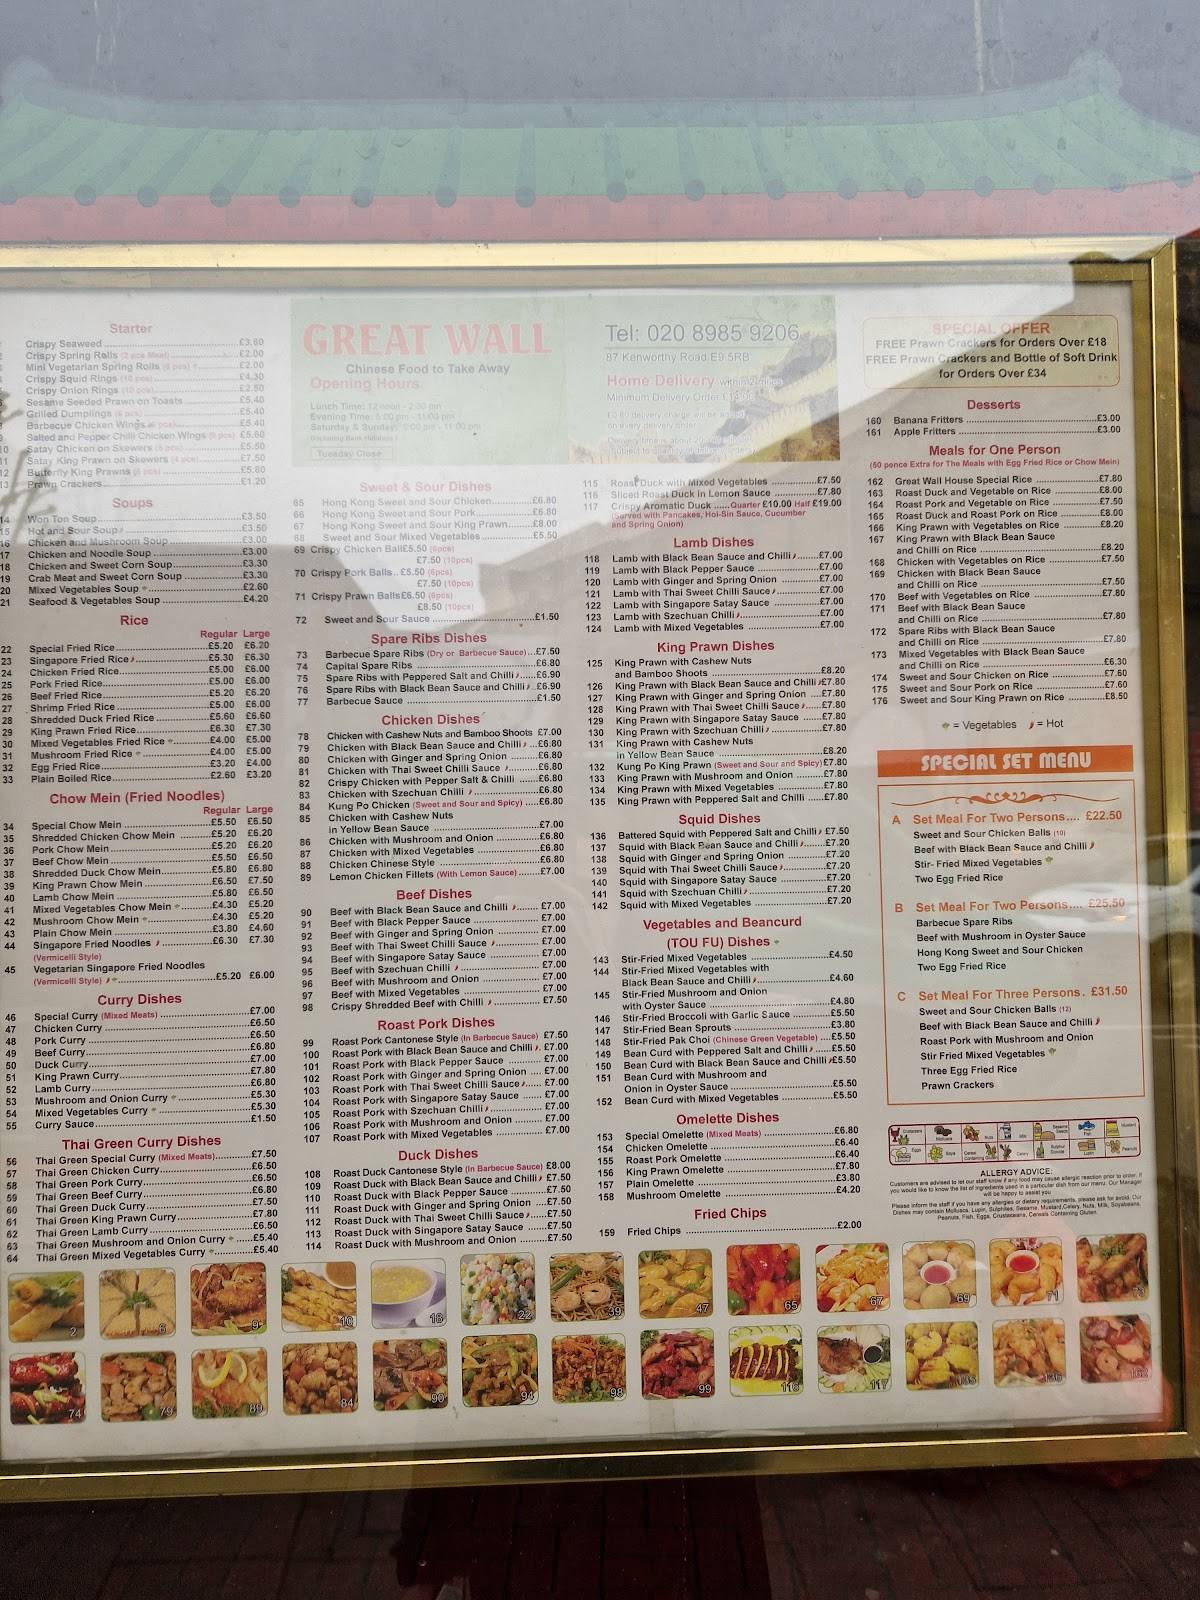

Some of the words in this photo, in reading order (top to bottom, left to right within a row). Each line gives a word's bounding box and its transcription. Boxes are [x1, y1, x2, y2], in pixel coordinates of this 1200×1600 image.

[109, 322, 153, 334] Starter
[604, 323, 639, 342] Tel:
[647, 322, 687, 343] 020
[692, 323, 743, 342] 8985
[749, 323, 802, 344] 9206
[932, 322, 996, 336] SPECIAL
[996, 322, 1050, 336] OFFER
[303, 322, 433, 355] GREAT
[442, 323, 551, 354] WALL
[875, 338, 907, 349] FREE
[909, 338, 944, 348] Prawn
[946, 337, 997, 348] Crackers
[999, 337, 1015, 347] for
[1018, 337, 1055, 347] Orders
[1058, 337, 1085, 347] Over
[1087, 336, 1106, 346] £18
[622, 351, 679, 364] Kenworthy
[679, 351, 709, 362] Road
[345, 363, 394, 374] Chinese
[398, 363, 428, 374] Food
[432, 364, 444, 374] to
[447, 363, 474, 374] Take
[478, 363, 510, 376] Away
[938, 368, 954, 379] for
[957, 368, 995, 378] Orders
[998, 368, 1025, 378] Over
[1027, 367, 1046, 377] £34
[310, 378, 371, 392] Opening
[376, 377, 420, 390] Hours
[607, 374, 649, 387] Home
[656, 374, 715, 388] Delivery
[967, 399, 1020, 410] Desserts
[929, 444, 964, 456] Meals
[968, 444, 986, 455] for
[989, 444, 1014, 455] One
[1017, 443, 1060, 454] Person
[360, 482, 400, 493] Sweet
[402, 482, 410, 493] &
[414, 480, 445, 492] Sour
[448, 480, 492, 492] Dishes
[111, 497, 154, 510] Soups
[673, 536, 708, 548] Lamb
[711, 536, 754, 547] Dishes
[0, 574, 10, 583] 19
[27, 573, 51, 582] Crab
[53, 573, 77, 582] Meat
[78, 573, 96, 581] and
[99, 572, 128, 581] Sweet
[130, 572, 154, 580] Corn
[156, 571, 182, 582] Soup
[243, 570, 268, 579] £3.30
[120, 614, 148, 625] Rice
[200, 629, 238, 640] Regular
[242, 629, 270, 639] Large
[371, 633, 408, 646] Spare
[411, 632, 440, 644] Ribs
[444, 632, 487, 643] Dishes
[657, 641, 686, 655] King
[689, 641, 728, 652] Prawn
[732, 640, 774, 651] Dishes
[381, 714, 432, 725] Chicken
[437, 713, 480, 725] Dishes
[962, 719, 1016, 732] Vegetables
[297, 732, 309, 741] 78
[326, 731, 363, 740] Chicken
[364, 731, 383, 739] with
[385, 730, 421, 739] Cashew
[422, 730, 443, 738] Nuts
[444, 729, 461, 738] and
[463, 729, 500, 737] Bamboo
[502, 728, 533, 736] Shoots
[537, 727, 562, 736] £7.00
[920, 753, 997, 771] SPECIAL
[1002, 752, 1033, 769] SET
[1038, 751, 1091, 768] MENU
[49, 793, 87, 804] Chow
[90, 791, 120, 803] Mein
[124, 791, 162, 805] (Fried
[167, 789, 224, 803] Noodles)
[678, 813, 714, 826] Squid
[718, 813, 760, 823] Dishes
[891, 814, 901, 824] A
[912, 814, 933, 824] Set
[935, 813, 963, 824] Meal
[966, 813, 987, 823] For
[989, 812, 1013, 823] Two
[1085, 810, 1122, 821] £22.50
[396, 888, 425, 900] Beef
[429, 888, 472, 899] Dishes
[642, 918, 711, 932] Vegetables
[714, 917, 738, 928] and
[742, 915, 801, 927] Beancurd
[916, 919, 960, 927] Barbecue
[962, 918, 989, 928] Spare
[992, 917, 1013, 925] Ribs
[3, 929, 15, 938] 43
[32, 929, 56, 938] Plain
[59, 928, 86, 936] Chow
[89, 927, 112, 936] Mein
[212, 924, 237, 933] £3.80
[248, 922, 274, 932] £4.60
[916, 933, 938, 941] Beef
[939, 933, 959, 941] with
[962, 932, 1010, 941] Mushroom
[1013, 931, 1022, 939] in
[1024, 931, 1056, 941] Oyster
[1057, 930, 1086, 939] Sauce
[666, 937, 697, 950] (TOU
[702, 936, 723, 950] FU)
[727, 936, 770, 947] Dishes
[897, 991, 906, 1001] C
[918, 990, 938, 1001] Set
[941, 989, 968, 1000] Meal
[972, 989, 992, 1000] For
[995, 988, 1028, 999] Three
[1090, 985, 1127, 996] £31.50
[97, 994, 133, 1007] Curry
[137, 993, 182, 1004] Dishes
[4, 1025, 16, 1034] 47
[34, 1024, 73, 1033] Chicken
[75, 1023, 102, 1033] Curry
[250, 1017, 275, 1027] £6.50
[377, 1019, 415, 1030] Roast
[418, 1018, 448, 1029] Pork
[451, 1017, 495, 1028] Dishes
[920, 1066, 947, 1075] Three
[949, 1066, 968, 1076] Egg
[970, 1065, 994, 1074] Fried
[997, 1064, 1017, 1073] Rice
[921, 1081, 950, 1090] Prawn
[953, 1080, 994, 1089] Crackers
[676, 1113, 732, 1125] Omelette
[736, 1112, 779, 1123] Dishes
[61, 1138, 89, 1150] Thai
[93, 1138, 133, 1149] Green
[137, 1136, 173, 1149] Curry
[177, 1135, 221, 1146] Dishes
[398, 1149, 431, 1161] Duck
[435, 1147, 478, 1160] Dishes
[980, 1168, 1018, 1177] ALLERGY
[694, 1208, 726, 1220] Fried
[730, 1207, 767, 1220] Chips
[599, 1228, 615, 1237] 159
[627, 1227, 651, 1236] Fried
[654, 1226, 681, 1236] Chips
[837, 1220, 862, 1229] £2.00
[695, 1303, 709, 1314] 47
[784, 1300, 799, 1311] 65
[517, 1309, 532, 1321] 22
[69, 1327, 77, 1337] 2
[697, 1383, 712, 1393] 99
[67, 1409, 82, 1419] 74
